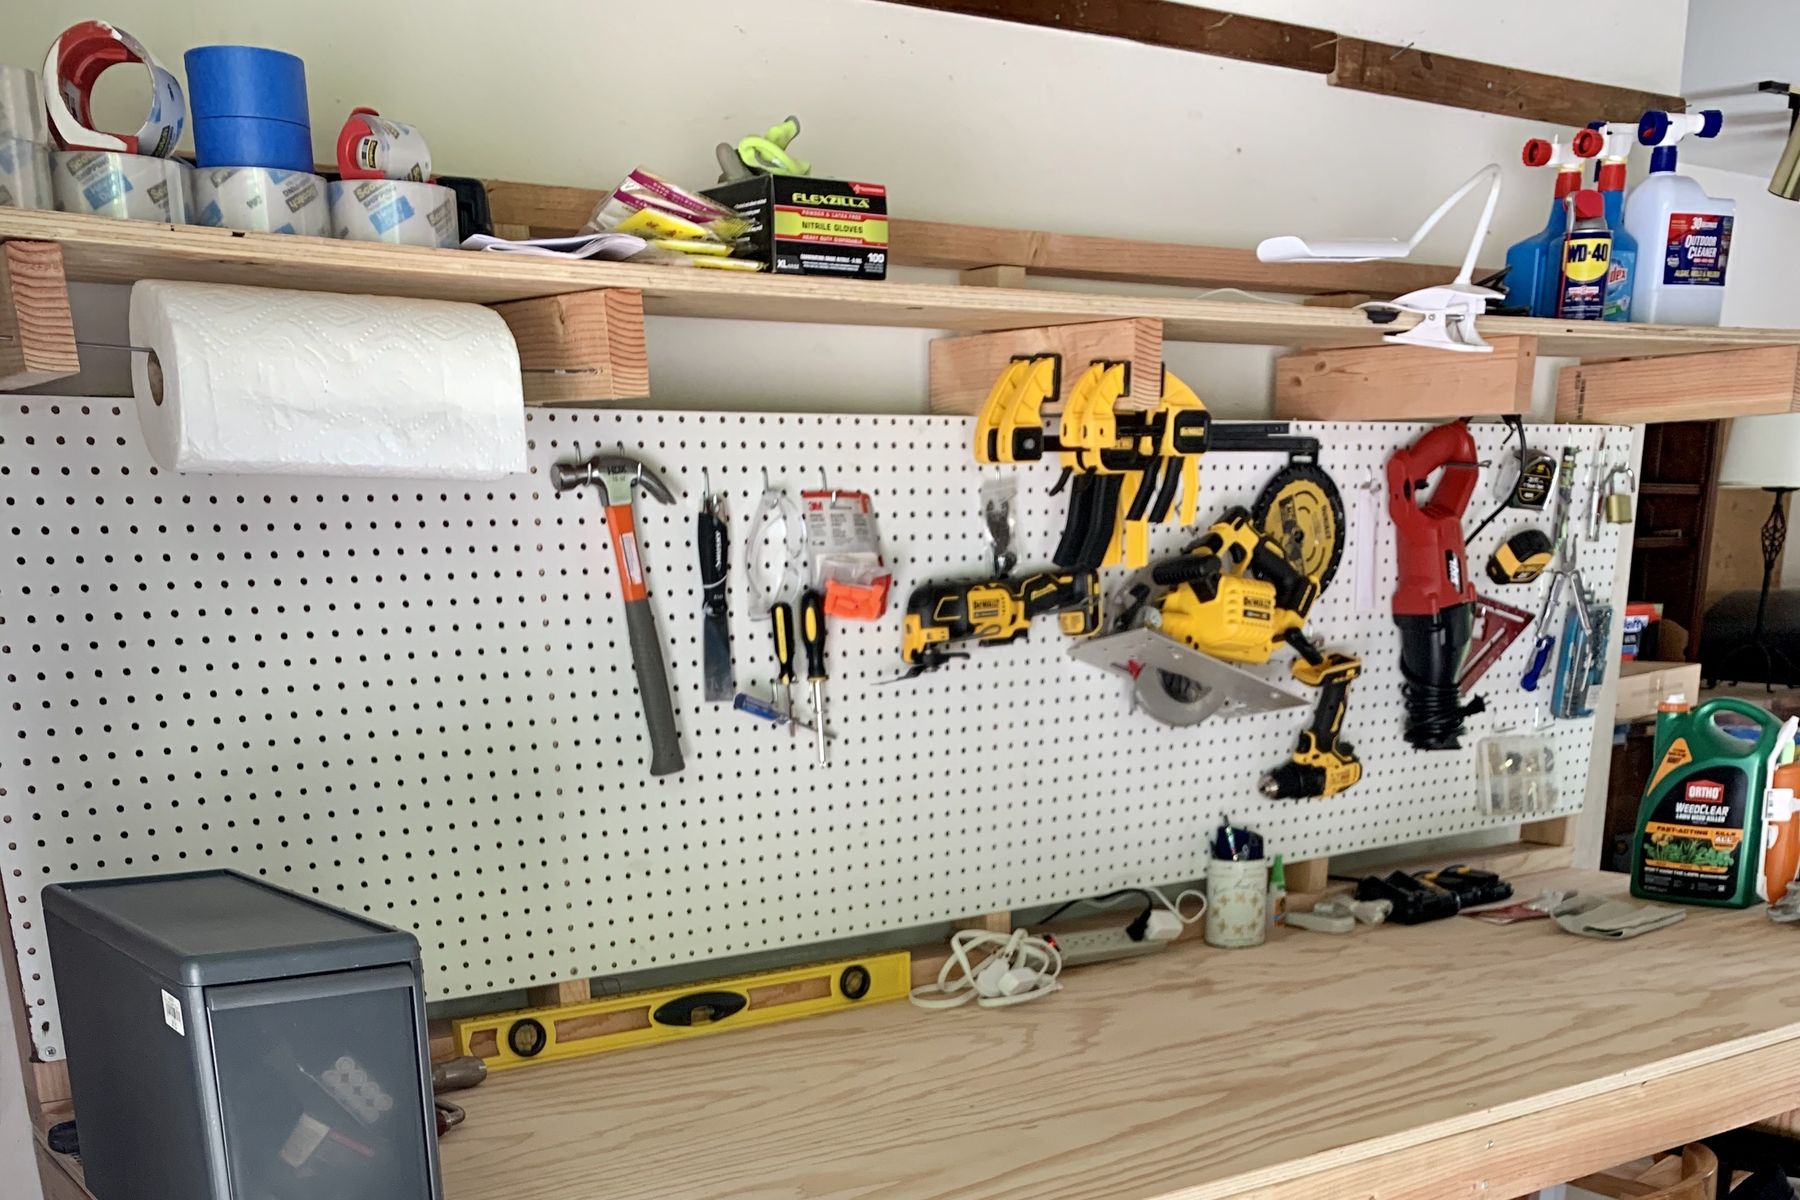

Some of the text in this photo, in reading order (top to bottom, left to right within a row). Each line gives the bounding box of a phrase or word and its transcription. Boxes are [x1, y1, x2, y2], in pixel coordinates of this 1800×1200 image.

[792, 192, 869, 208] FLEXZILLA
[802, 221, 863, 233] NITRILE GLOVES
[1685, 235, 1717, 248] OUTDOOR
[1567, 244, 1608, 262] WD-40
[1687, 246, 1717, 259] CLEANER
[809, 501, 823, 511] 3M
[1688, 786, 1721, 800] ORTHO
[1676, 803, 1729, 816] WEEDCLEAR
[1657, 826, 1708, 836] FAST-ACTING
